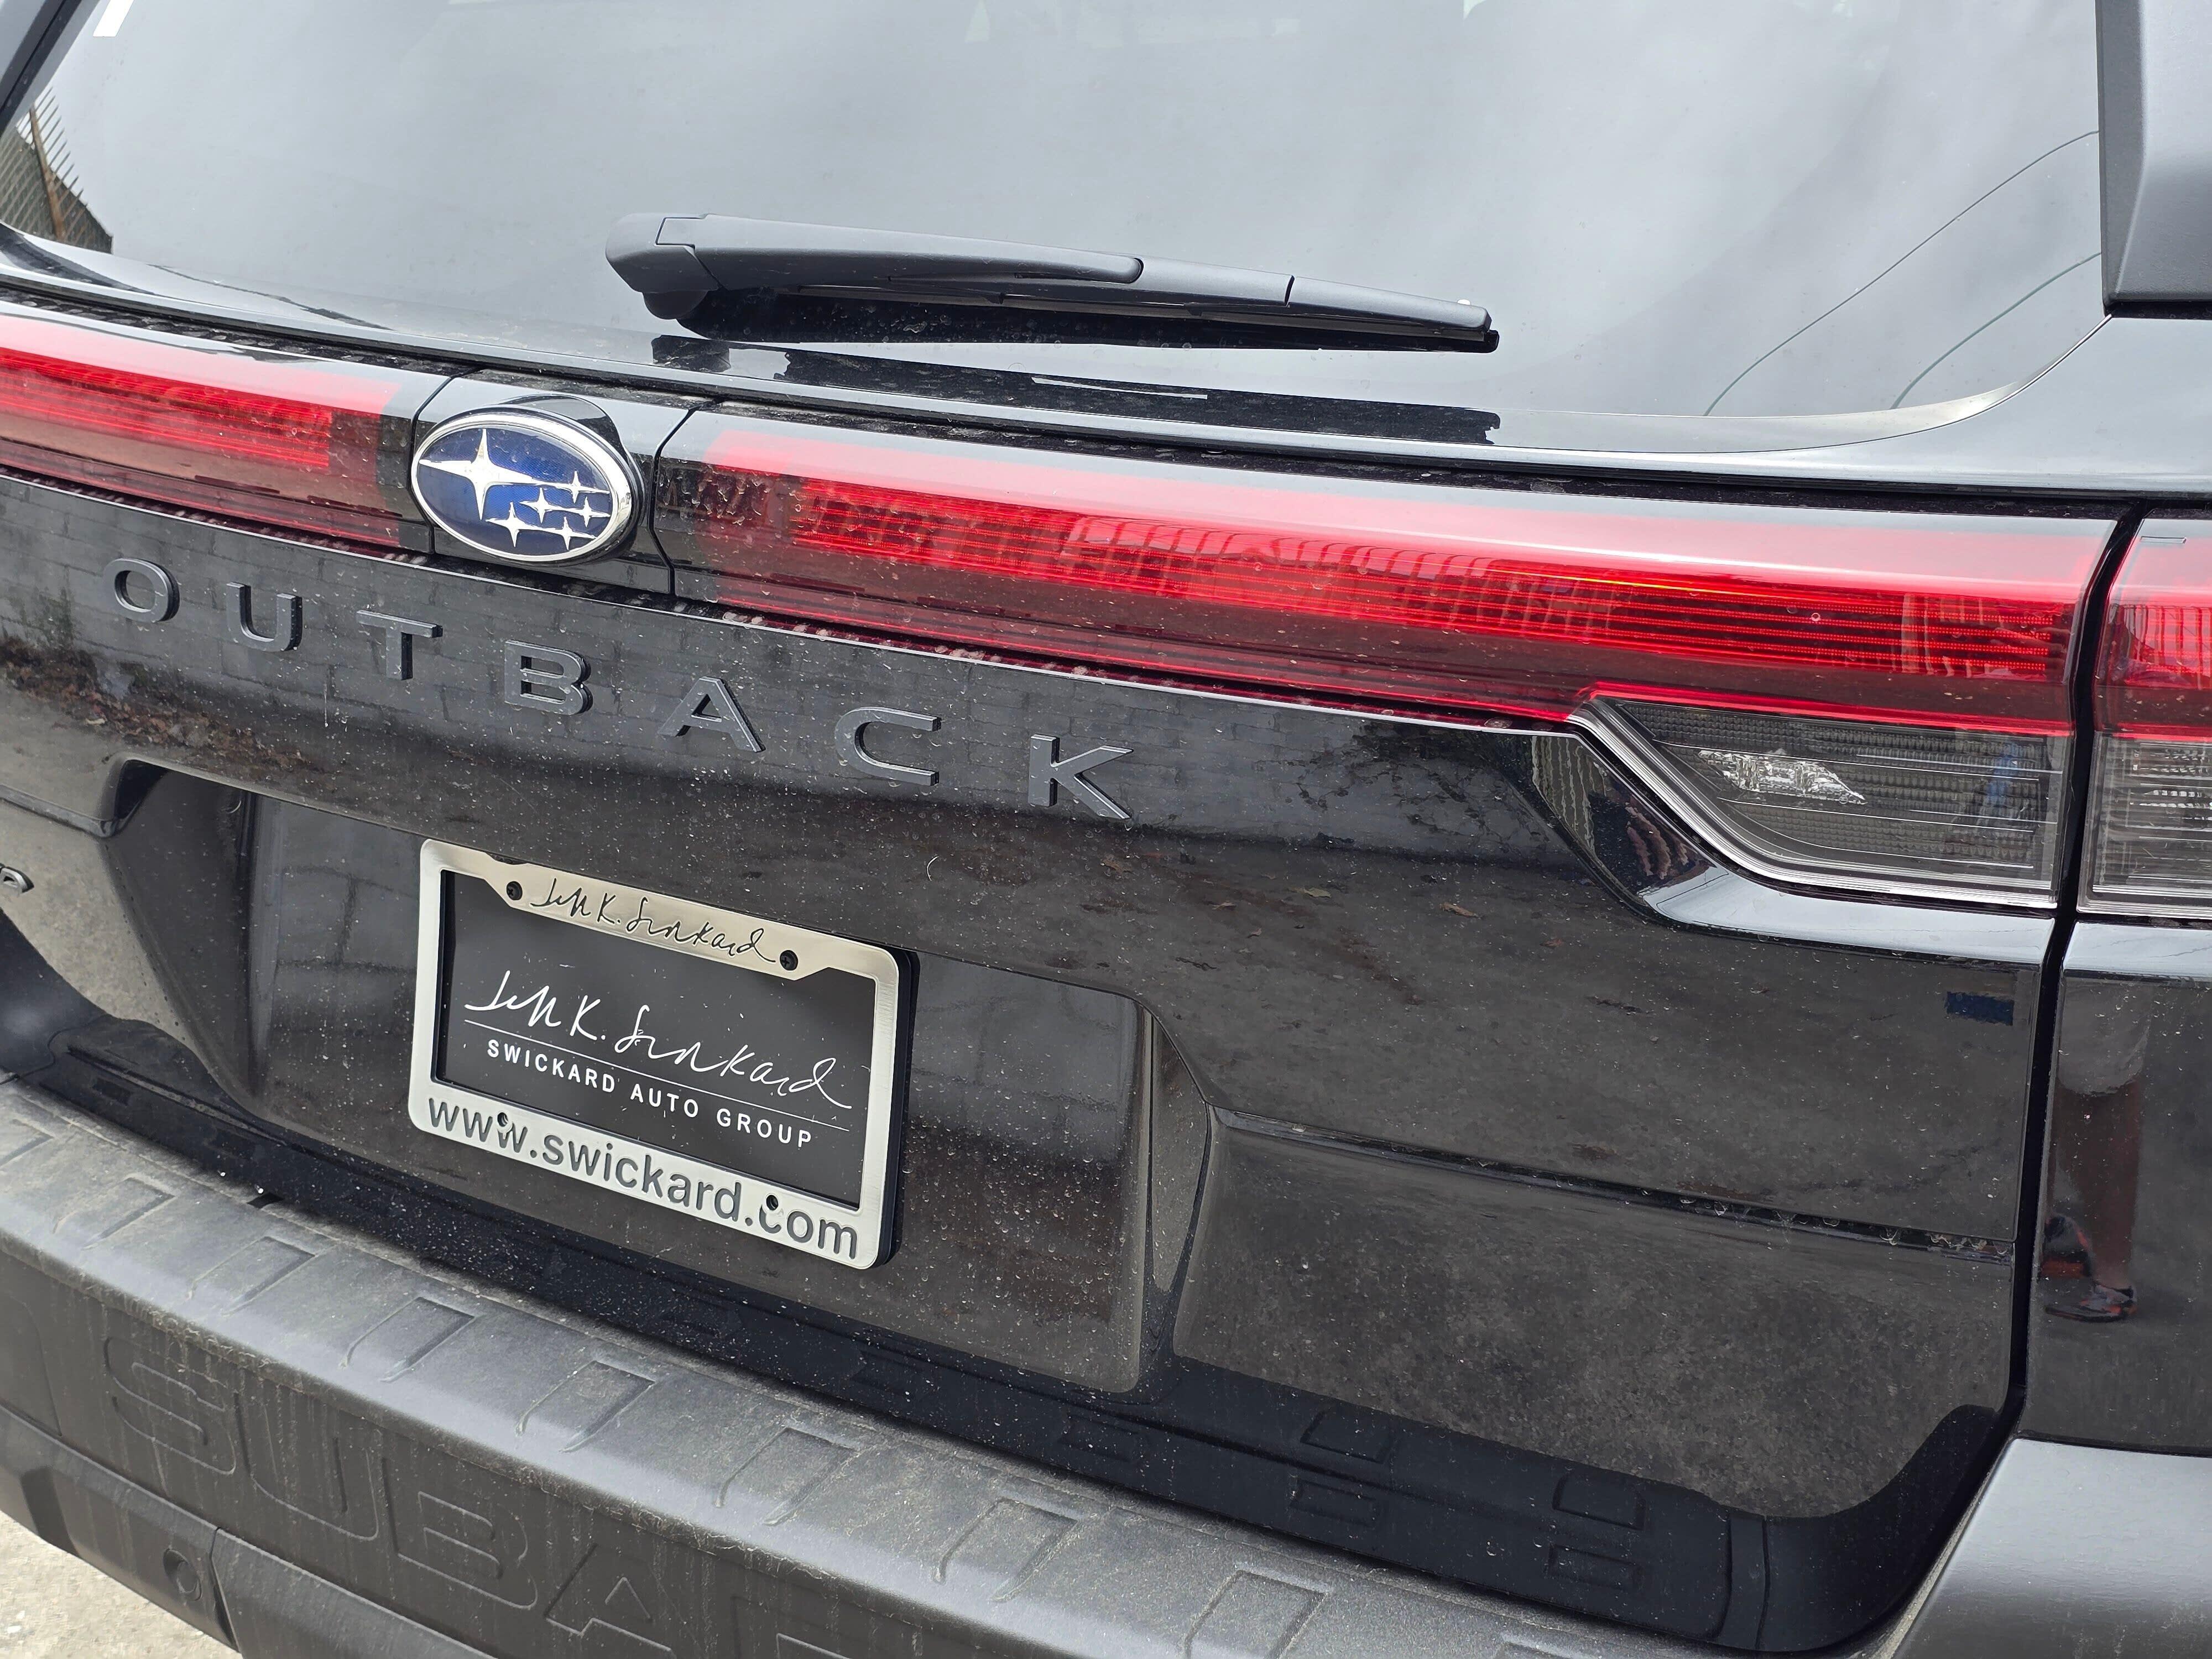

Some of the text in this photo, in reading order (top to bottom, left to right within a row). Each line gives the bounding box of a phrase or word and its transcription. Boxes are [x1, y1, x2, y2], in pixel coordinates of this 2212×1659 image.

[109, 557, 1134, 820] OUTBACK
[487, 1039, 811, 1148] SWICKARD AUTO GROUP
[428, 1097, 858, 1261] www.swickard.com
